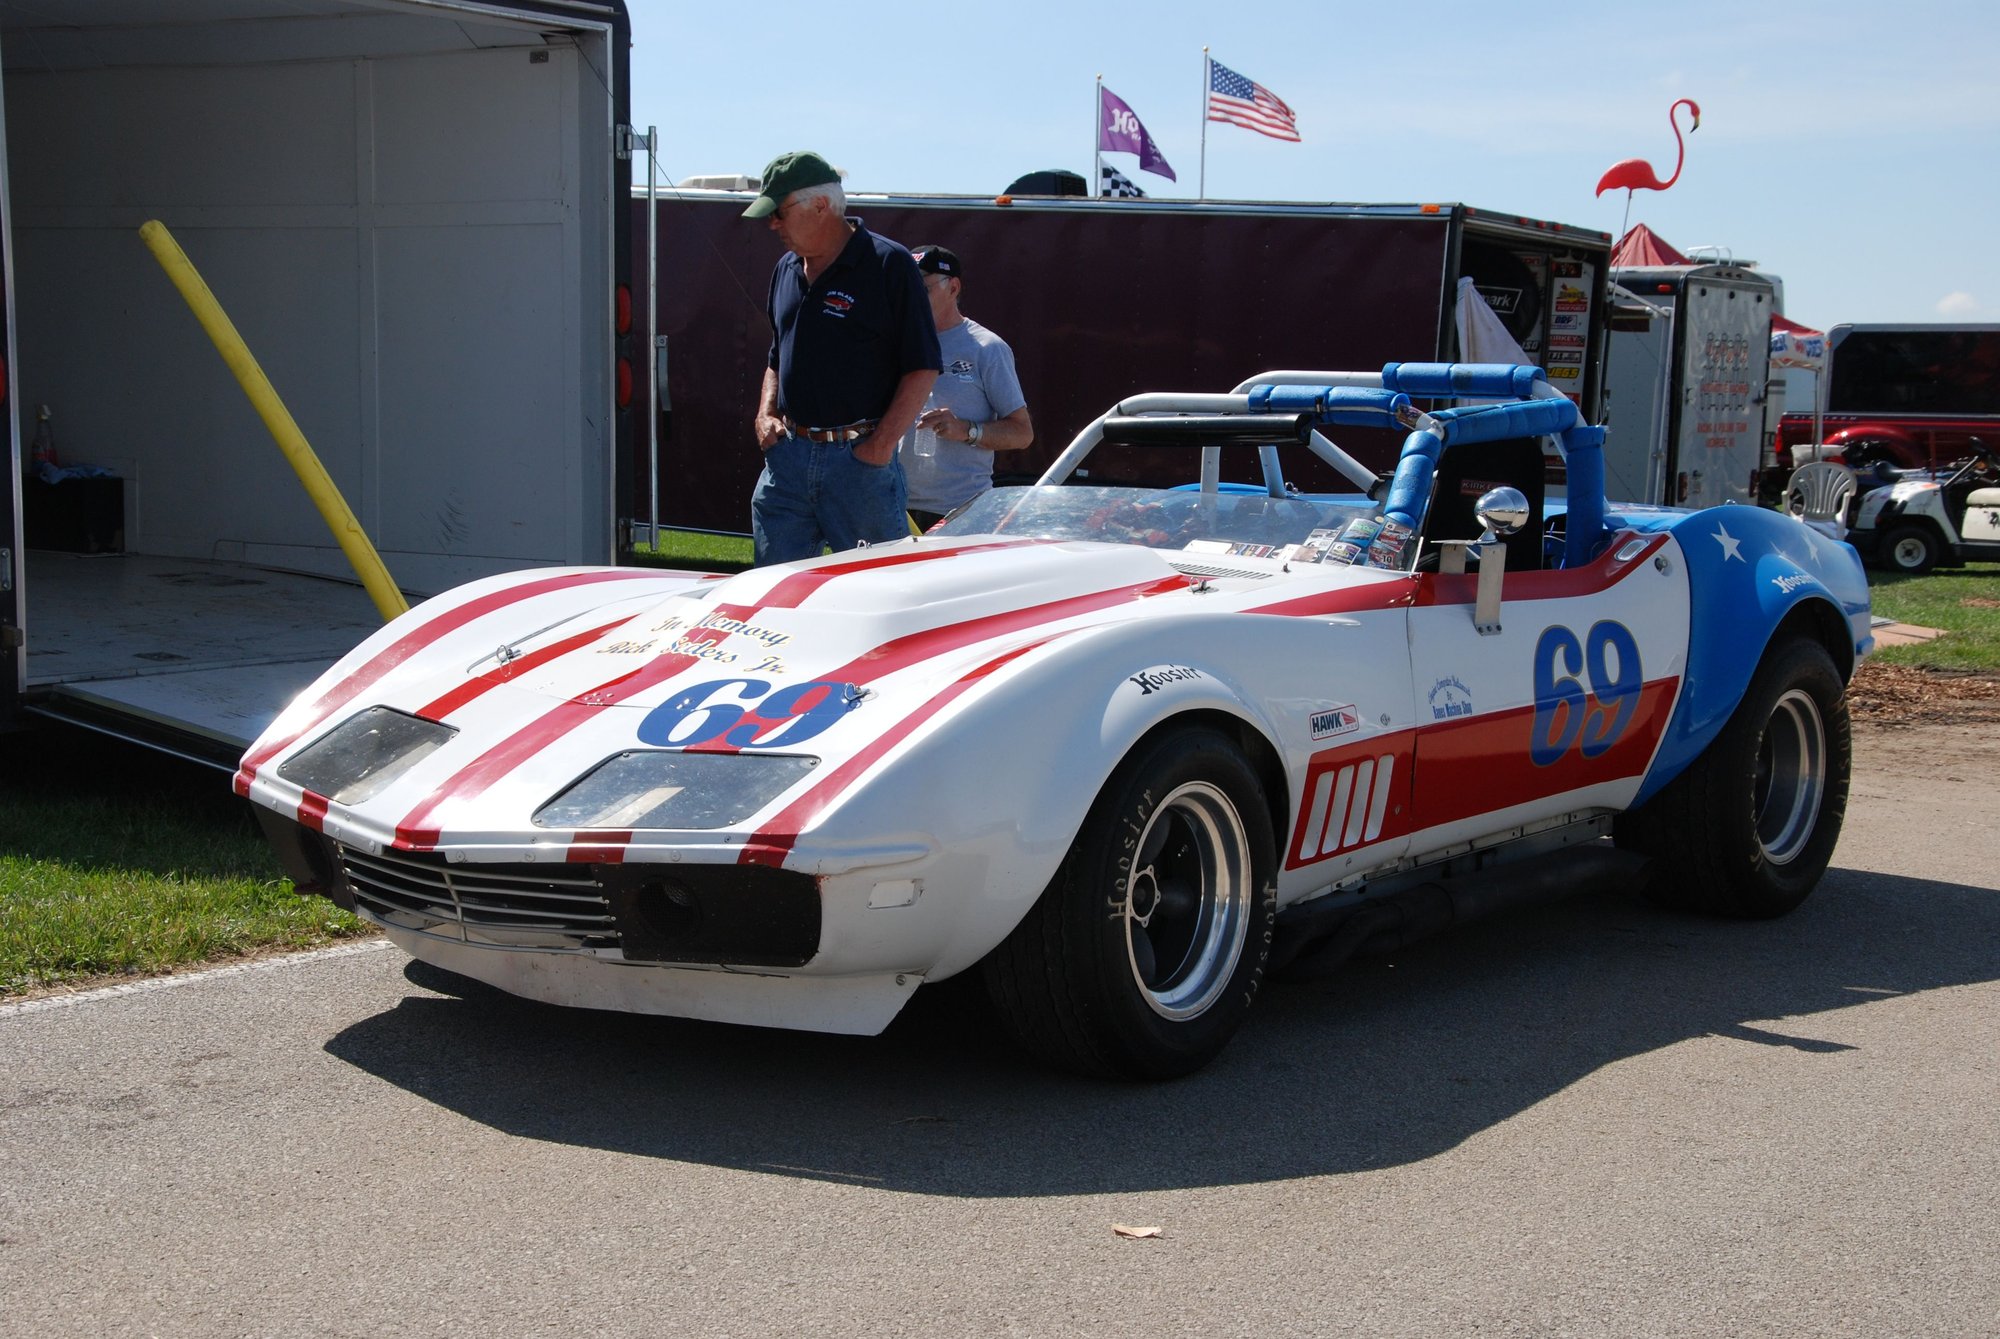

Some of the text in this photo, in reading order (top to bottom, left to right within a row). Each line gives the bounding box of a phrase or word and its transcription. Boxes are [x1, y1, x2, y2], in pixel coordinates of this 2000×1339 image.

[596, 638, 659, 655] Rick
[650, 611, 791, 647] In Memory
[1129, 664, 1202, 695] Hoosier
[1530, 619, 1643, 767] 69
[637, 679, 851, 748] 69
[1311, 711, 1342, 733] HAWK
[1107, 788, 1153, 920] Hoosier
